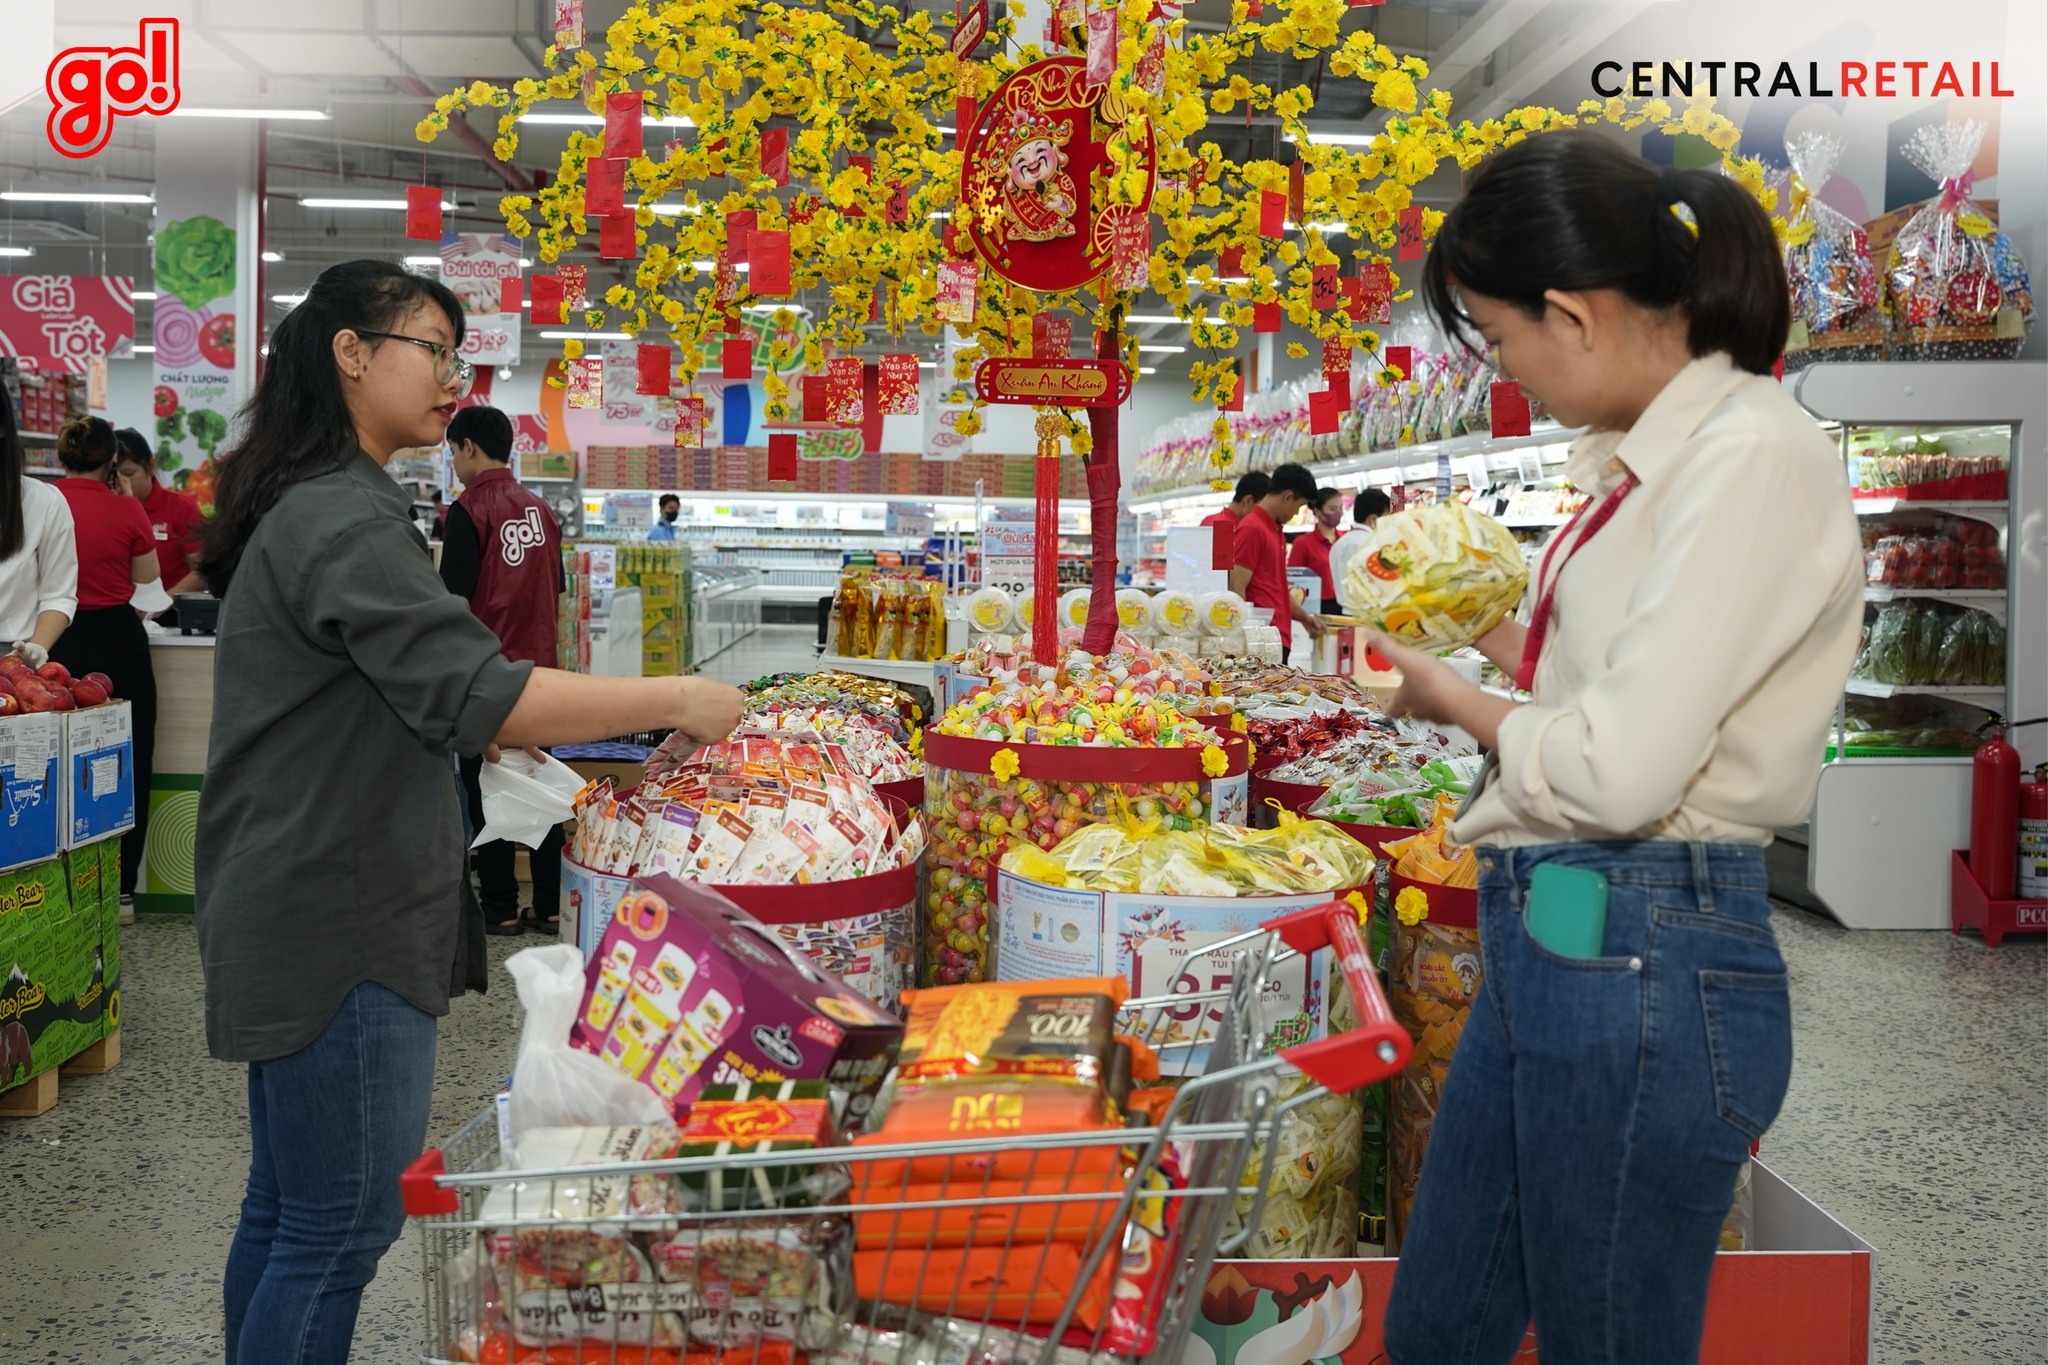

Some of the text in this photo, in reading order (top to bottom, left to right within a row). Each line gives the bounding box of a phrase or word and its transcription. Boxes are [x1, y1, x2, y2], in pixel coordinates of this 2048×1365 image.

[13, 275, 75, 312] Giá
[42, 315, 106, 358] Tốt
[160, 370, 189, 383] CHẤT
[1001, 371, 1035, 388] Xuân
[1038, 372, 1058, 389] An
[605, 402, 629, 419] 75
[500, 507, 546, 567] go!
[15, 882, 43, 914] Bear
[16, 980, 46, 1019] Bear
[805, 1027, 837, 1046] DRINK
